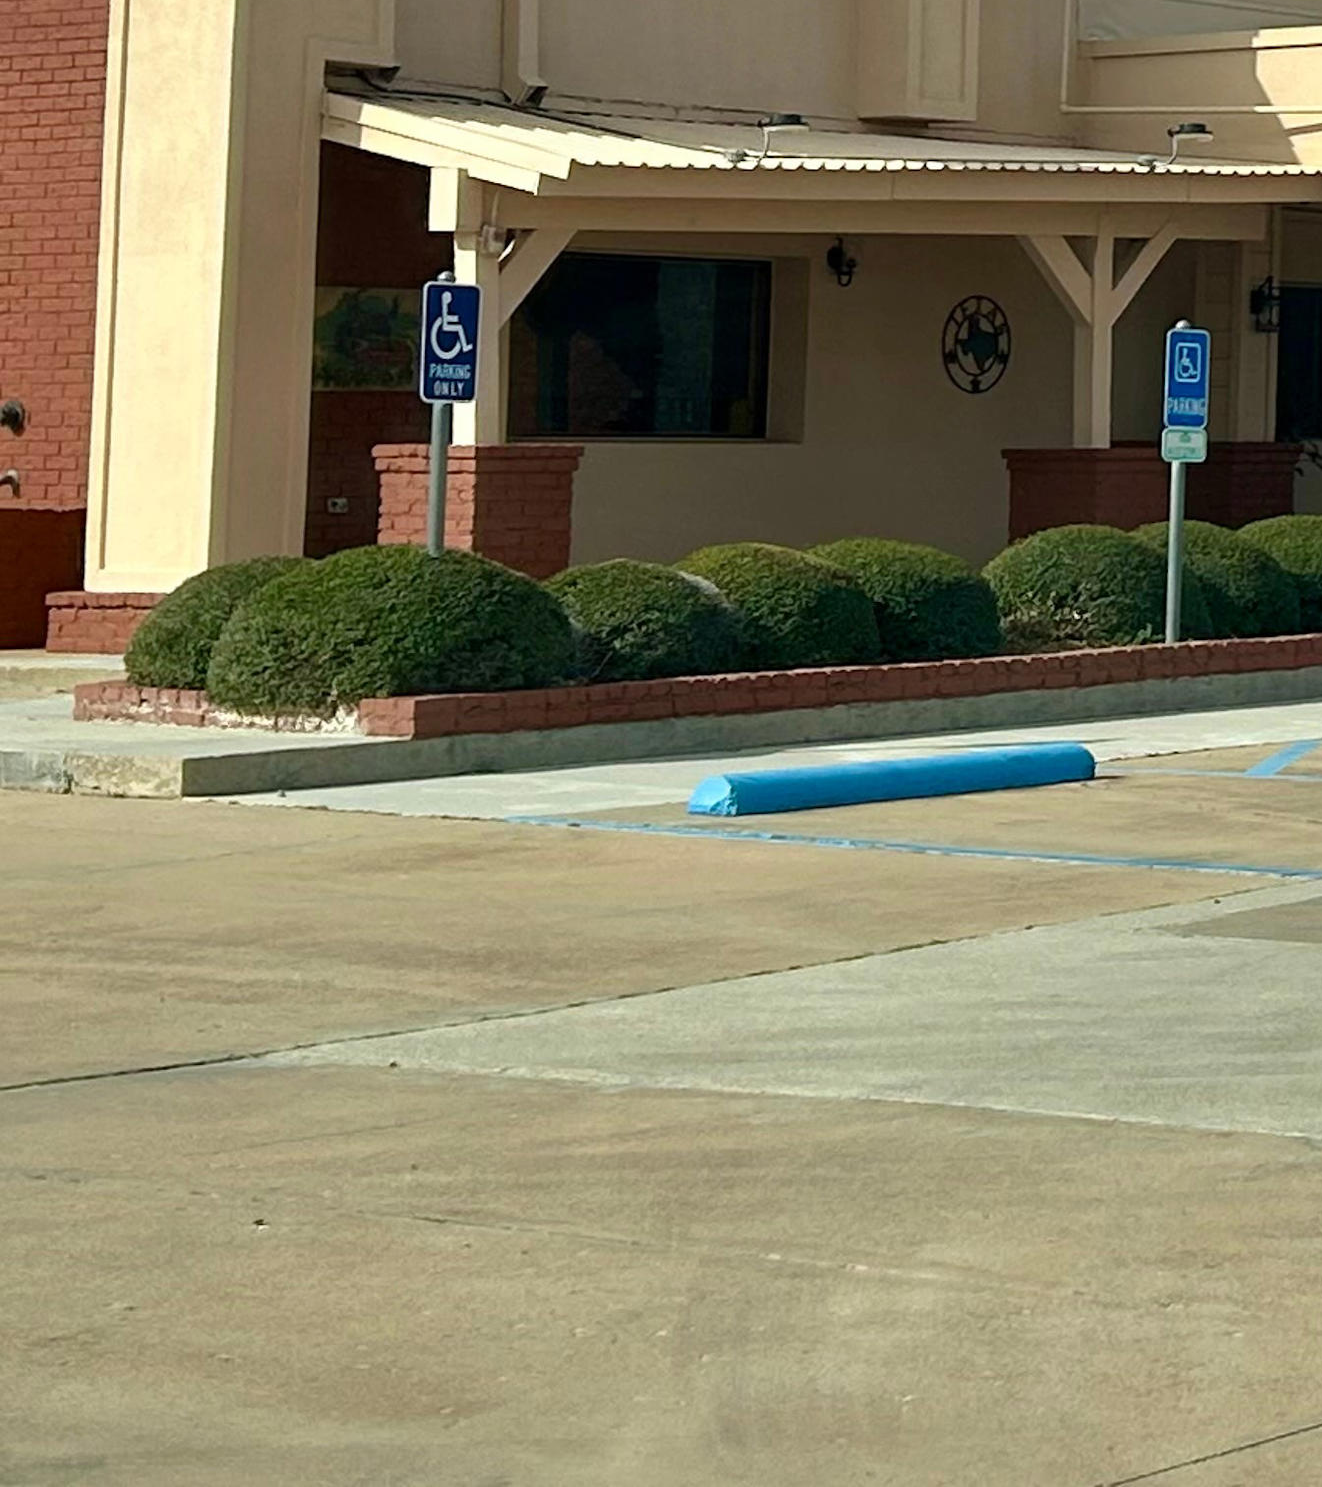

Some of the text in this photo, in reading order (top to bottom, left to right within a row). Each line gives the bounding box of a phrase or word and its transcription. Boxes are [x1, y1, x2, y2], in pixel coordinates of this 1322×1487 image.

[428, 363, 472, 380] PARKING
[433, 380, 465, 396] ONLY
[1167, 397, 1206, 416] PARKING
